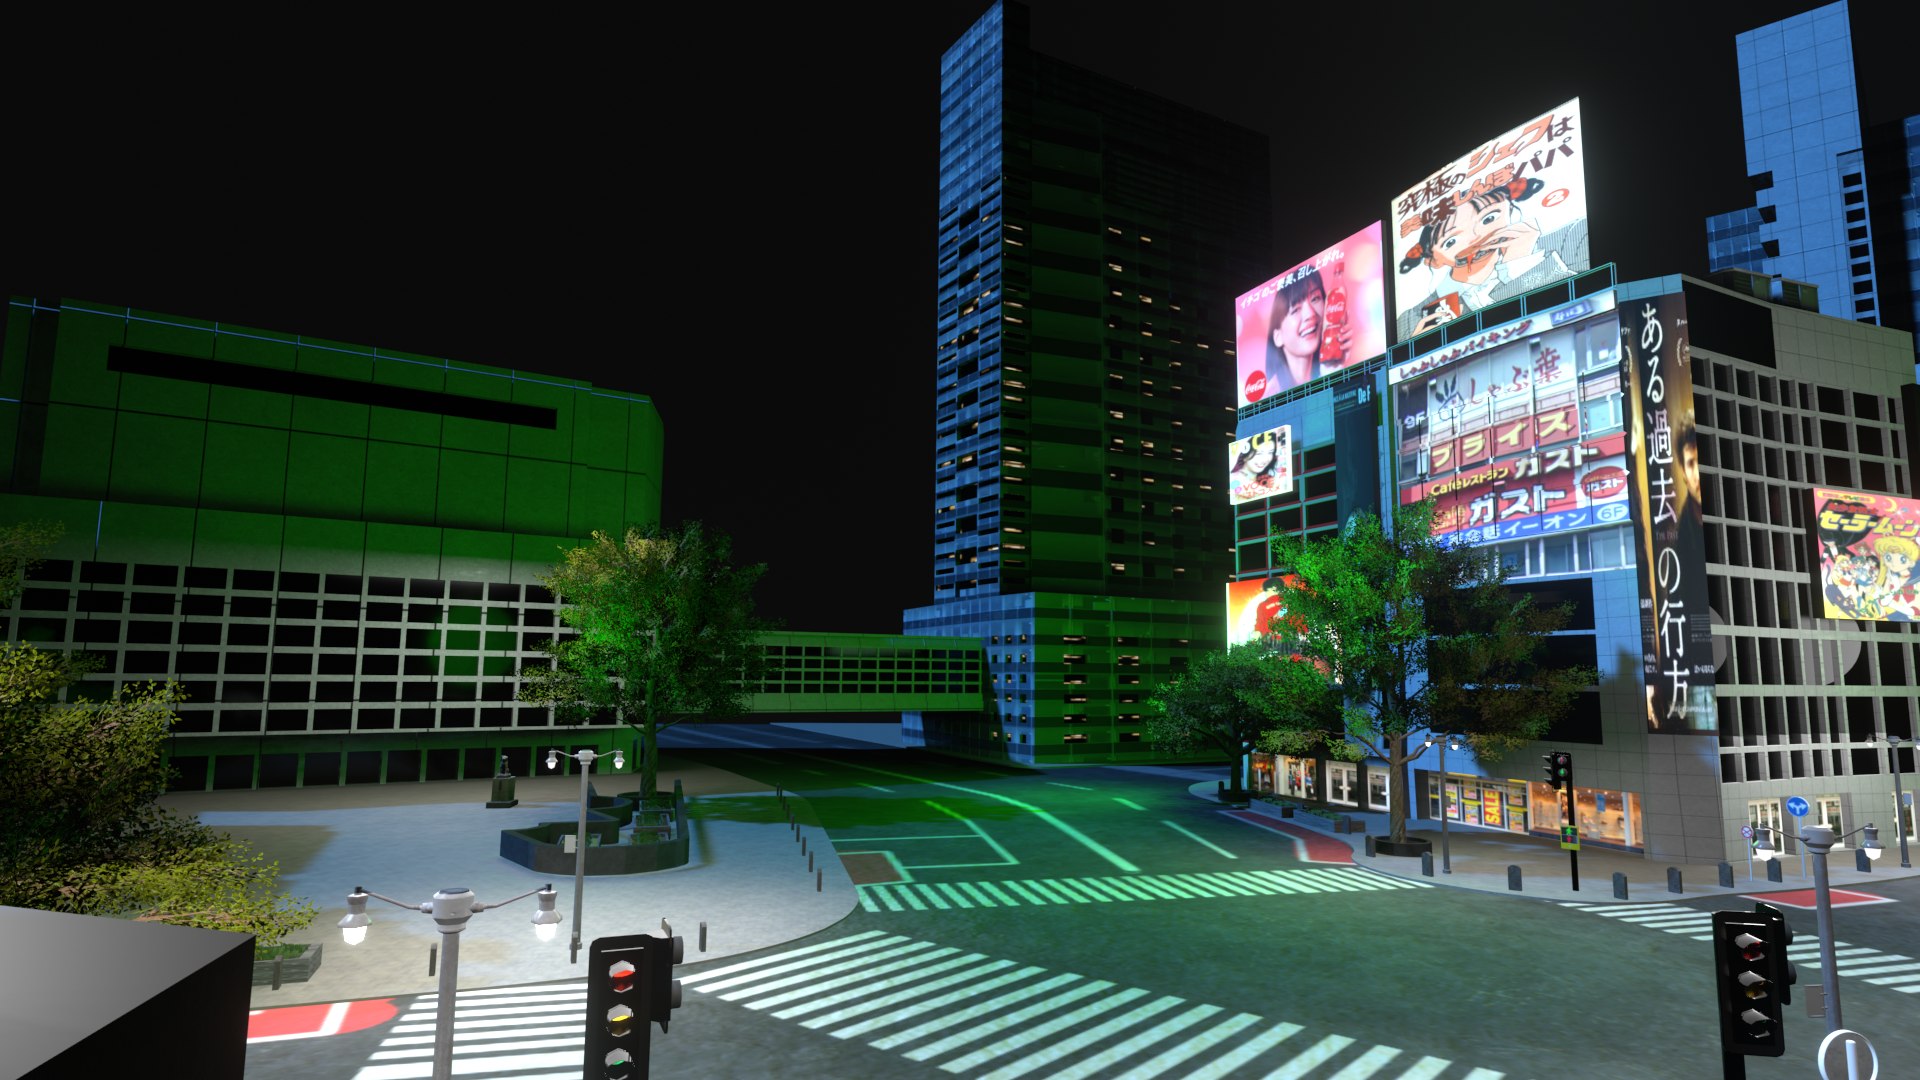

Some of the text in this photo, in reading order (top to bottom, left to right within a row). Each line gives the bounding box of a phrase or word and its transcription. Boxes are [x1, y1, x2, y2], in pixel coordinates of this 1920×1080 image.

[1471, 347, 1562, 405] しゃぶ葉
[1404, 411, 1427, 429] 9F
[1514, 444, 1598, 480] ガスト
[1470, 485, 1565, 526] ガスト
[1641, 303, 1690, 720] ある過去の行方
[1820, 510, 1920, 538] セーラームーン
[1484, 790, 1500, 825] SALE
